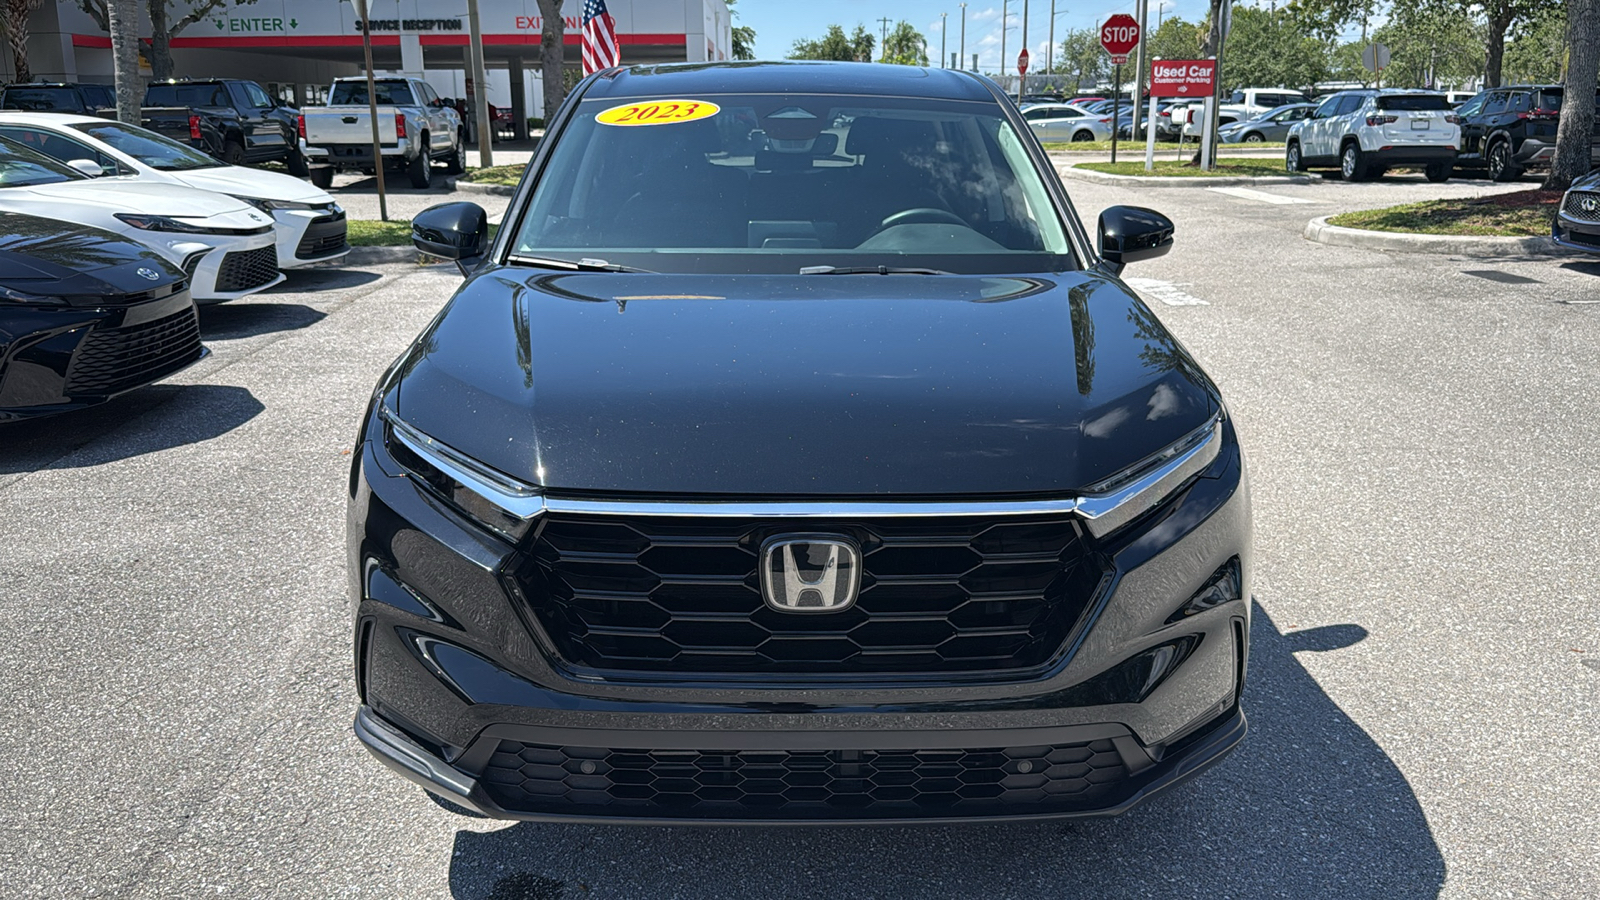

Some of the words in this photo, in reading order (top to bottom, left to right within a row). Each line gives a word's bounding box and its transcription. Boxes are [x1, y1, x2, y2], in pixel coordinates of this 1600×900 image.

[230, 18, 284, 31] ENTER
[355, 20, 399, 31] SRVICE
[402, 19, 462, 31] RECEPTION
[515, 16, 544, 29] EXI
[1103, 27, 1138, 43] STOP
[1154, 66, 1187, 78] Used
[1188, 65, 1213, 77] Car
[614, 103, 700, 123] 2023
